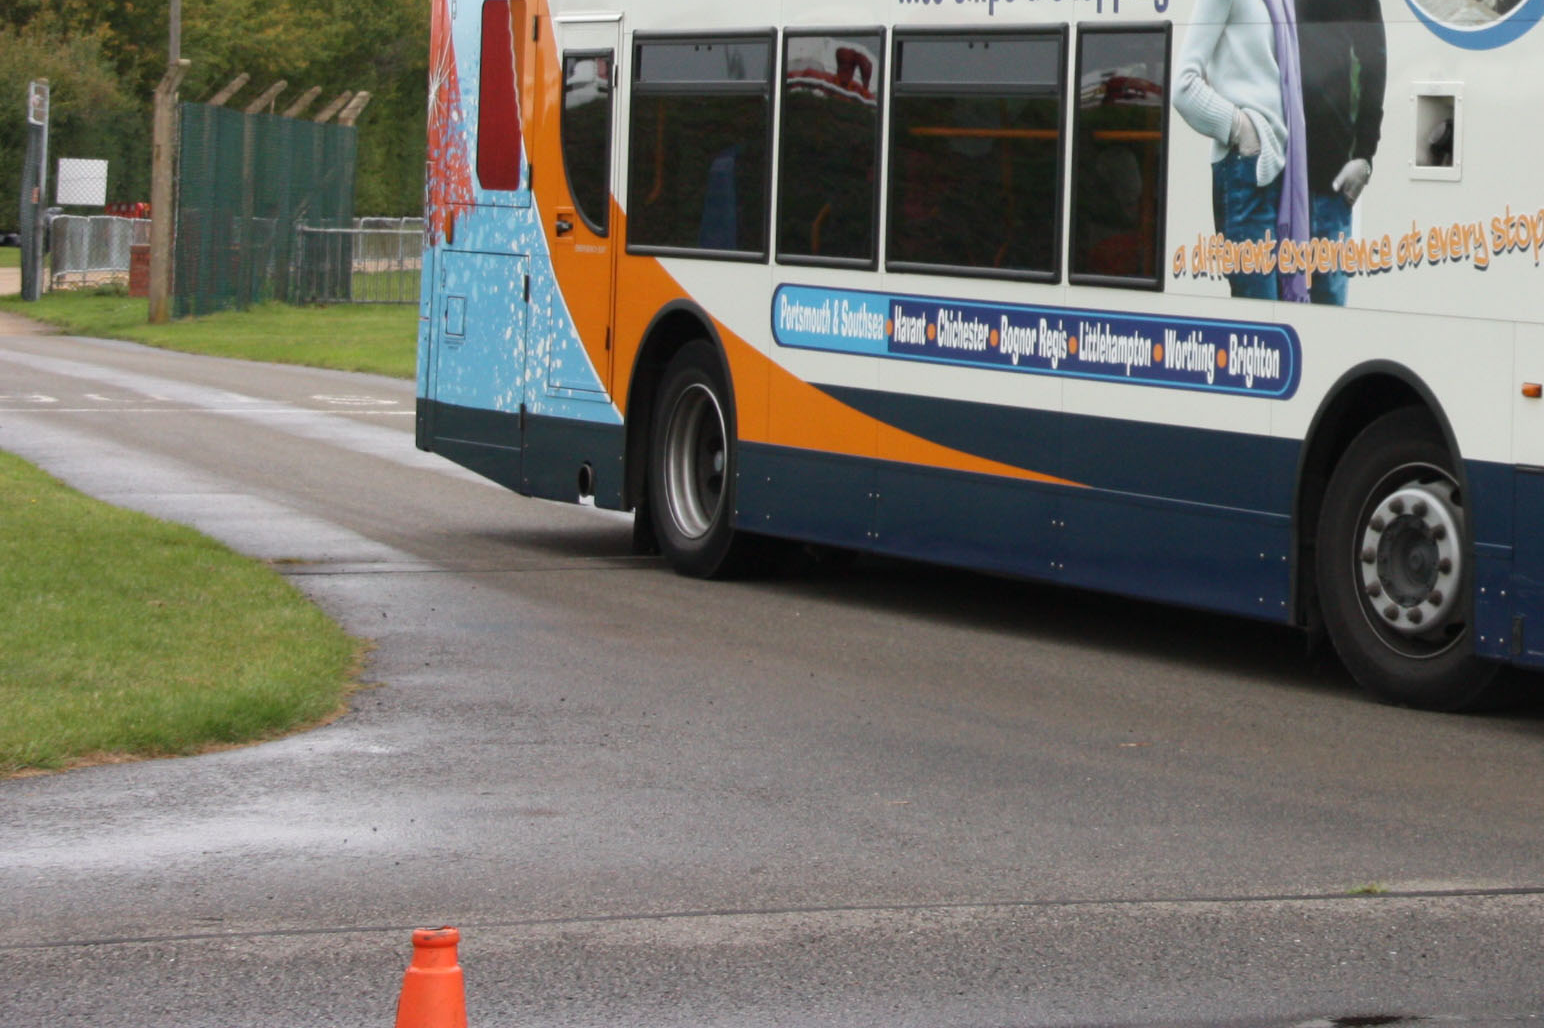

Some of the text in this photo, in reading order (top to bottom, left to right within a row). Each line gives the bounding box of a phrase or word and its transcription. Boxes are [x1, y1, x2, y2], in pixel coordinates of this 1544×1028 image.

[1173, 241, 1187, 275] a
[1191, 229, 1278, 278] different
[1278, 231, 1394, 289] experience
[1396, 220, 1424, 268] at
[1427, 221, 1489, 271] every
[780, 294, 884, 341] Portsmouth & Southsea
[894, 305, 1280, 389] Havant Chichester Bognor Regis Littlehampton Worthing Brighton
